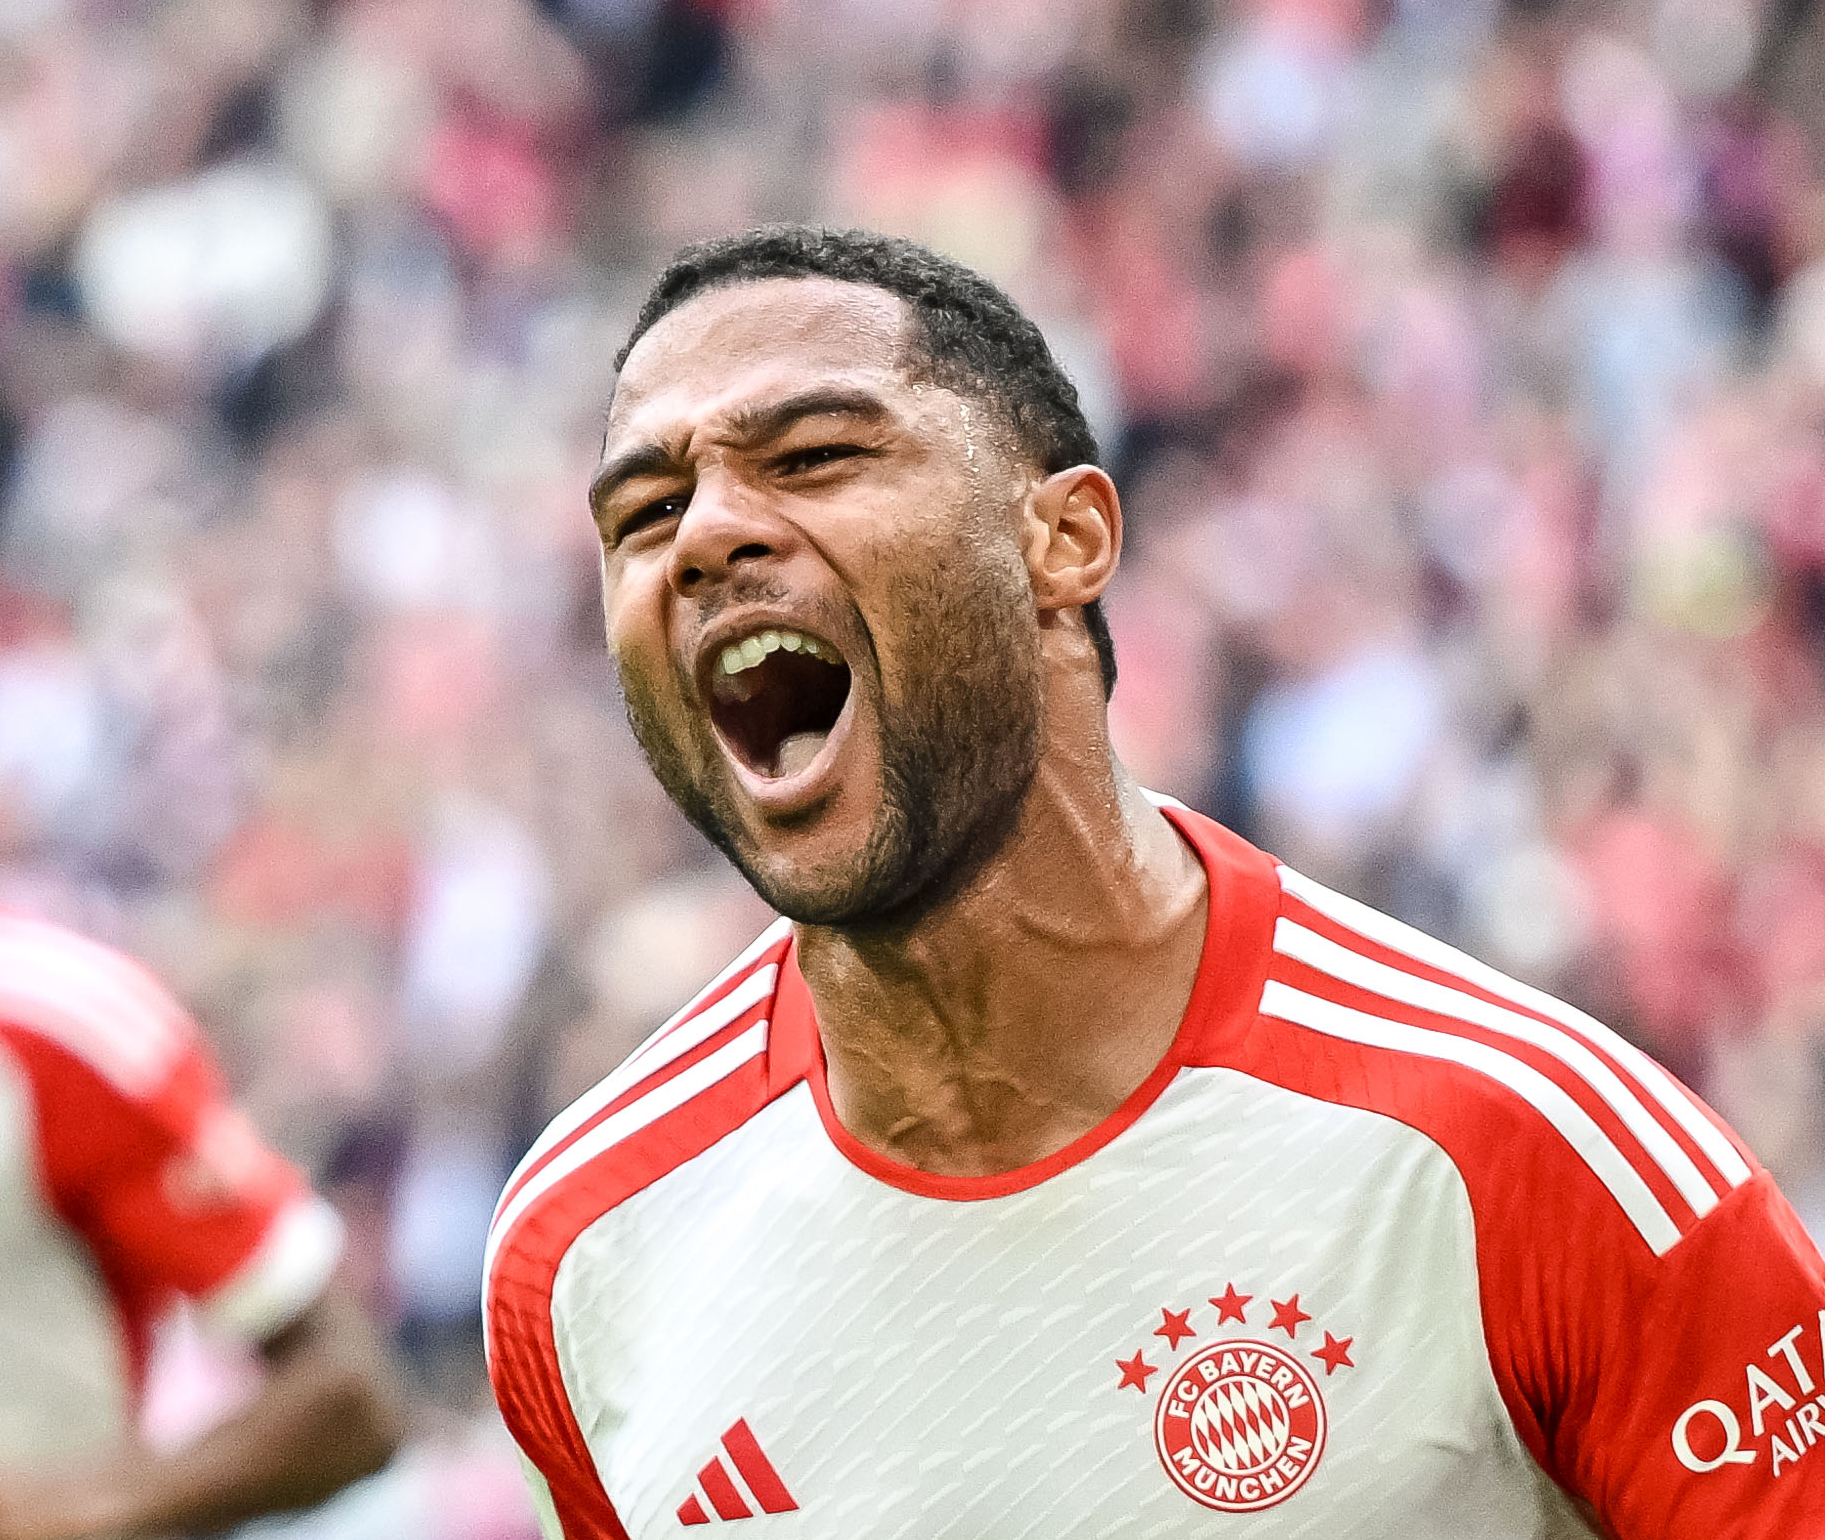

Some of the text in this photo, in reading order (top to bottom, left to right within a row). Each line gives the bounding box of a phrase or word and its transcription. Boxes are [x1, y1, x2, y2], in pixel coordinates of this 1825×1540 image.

[1168, 1350, 1310, 1420] FC BAYERN
[1171, 1435, 1314, 1500] MÜNCHEN
